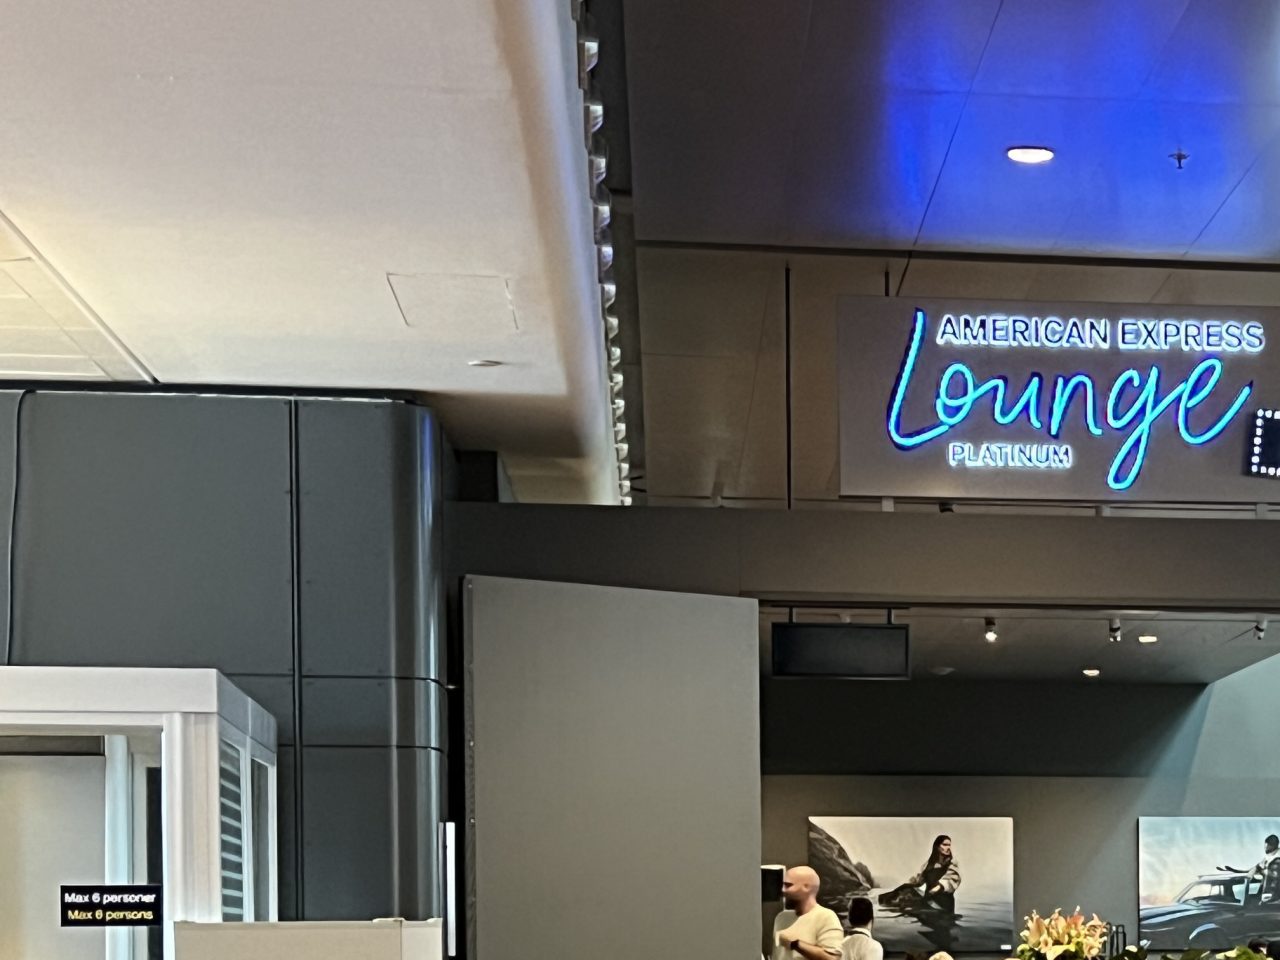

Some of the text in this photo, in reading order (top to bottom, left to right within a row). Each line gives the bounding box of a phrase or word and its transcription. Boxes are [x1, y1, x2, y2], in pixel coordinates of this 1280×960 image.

[936, 314, 1266, 352] AMERICAN EXPRESS
[887, 307, 1253, 491] Lounge
[948, 442, 1073, 469] PLATINUM
[64, 892, 156, 904] Max 6 personer
[67, 909, 153, 921] Max 6 persons
